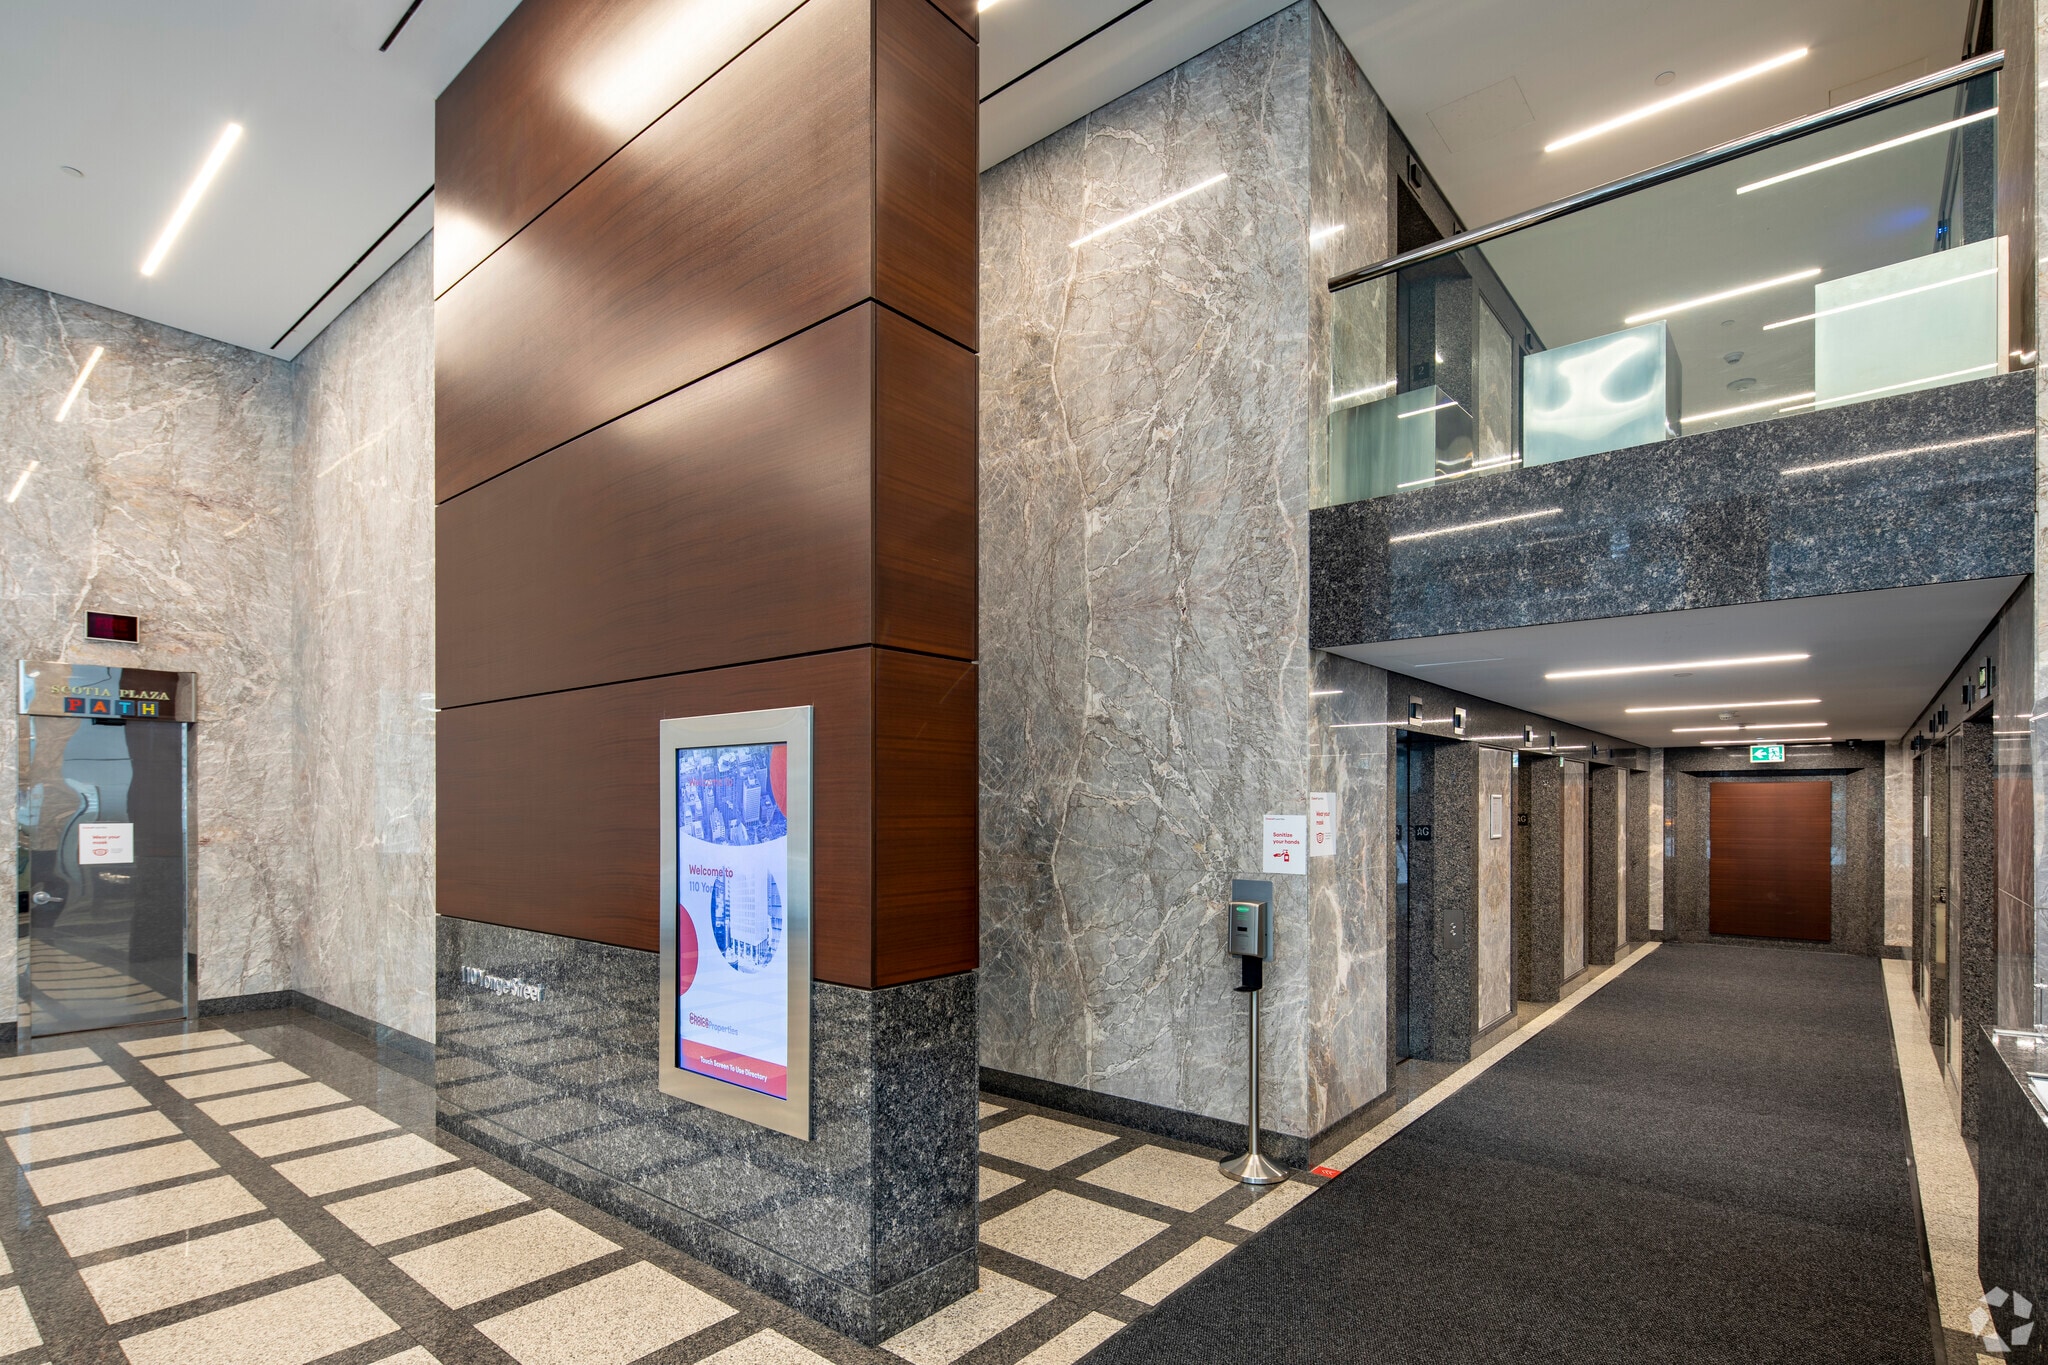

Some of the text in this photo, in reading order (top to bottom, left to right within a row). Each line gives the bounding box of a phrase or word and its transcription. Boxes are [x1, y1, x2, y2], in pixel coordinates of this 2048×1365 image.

[50, 685, 170, 701] SCOTIA PLAZA
[67, 698, 155, 715] PATH
[689, 863, 734, 878] Welcome to
[689, 880, 700, 892] 110
[461, 965, 545, 1002] 110 Yonge Street
[700, 1055, 768, 1083] Touch Screen To Use Directory
